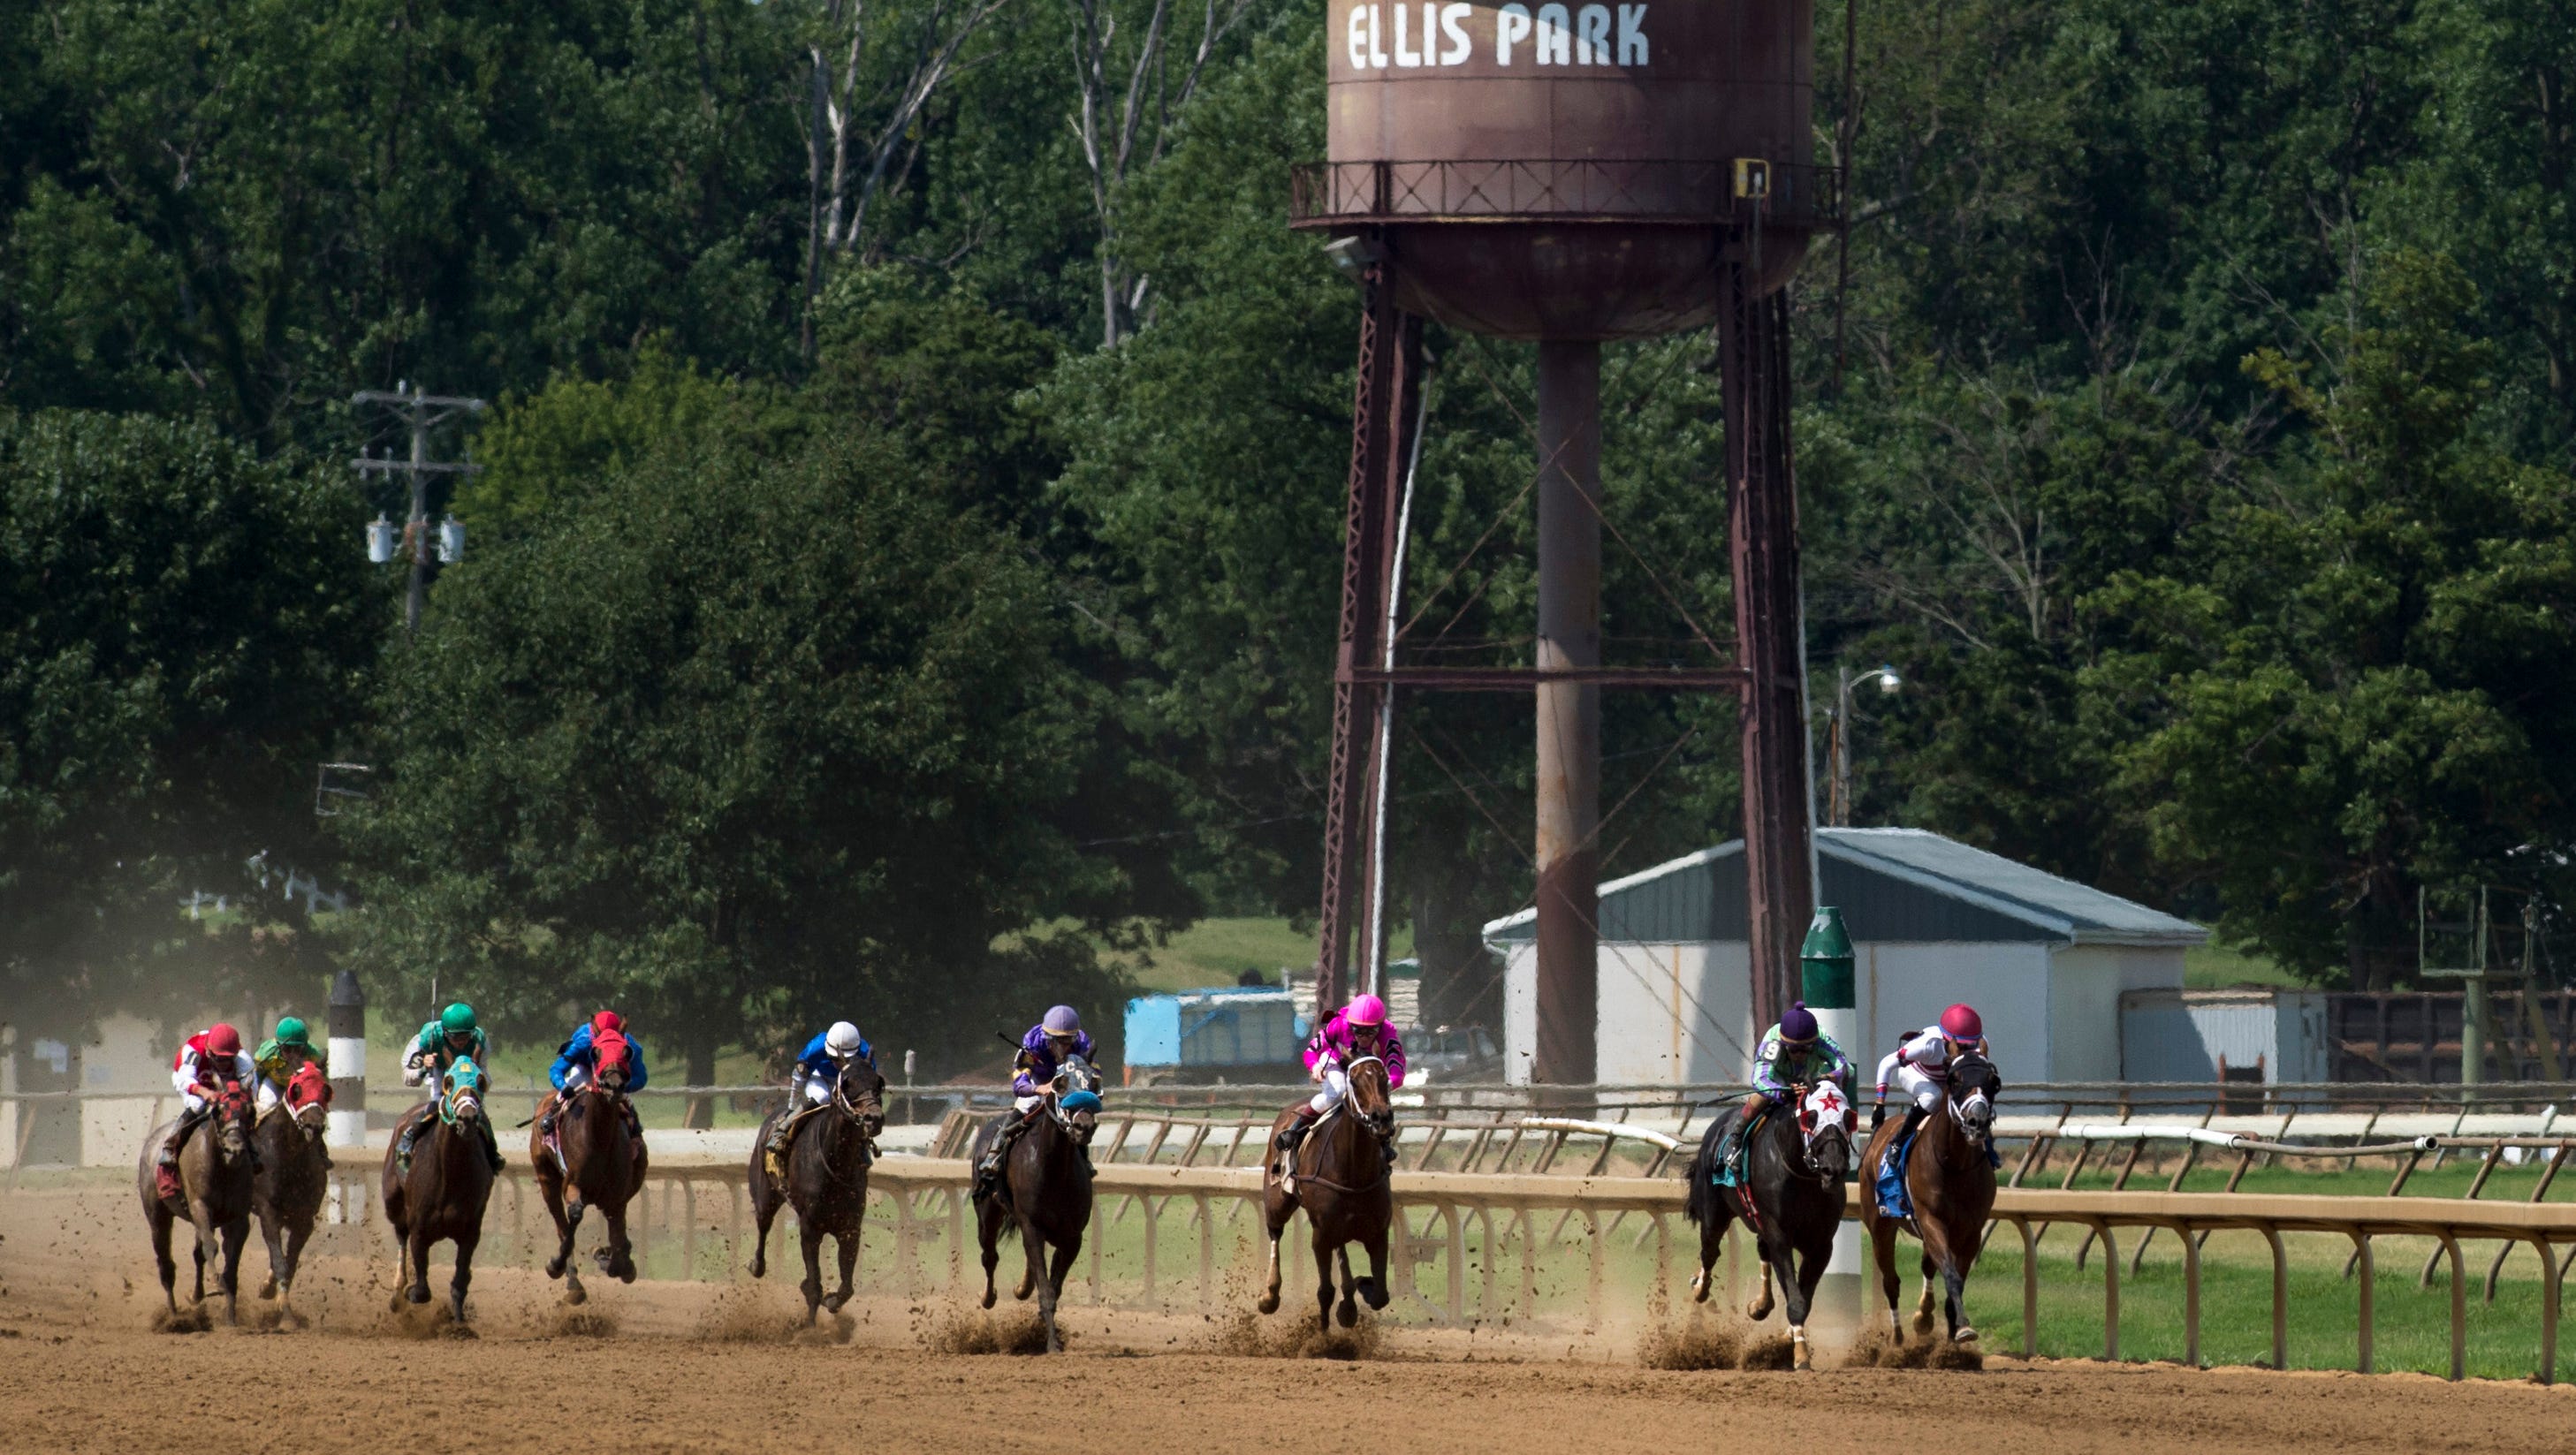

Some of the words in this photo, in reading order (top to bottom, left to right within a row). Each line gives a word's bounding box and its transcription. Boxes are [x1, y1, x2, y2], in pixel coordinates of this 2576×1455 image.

[1348, 2, 1472, 70] ELLIS
[1497, 3, 1649, 65] PARK
[1764, 1041, 1780, 1060] 9
